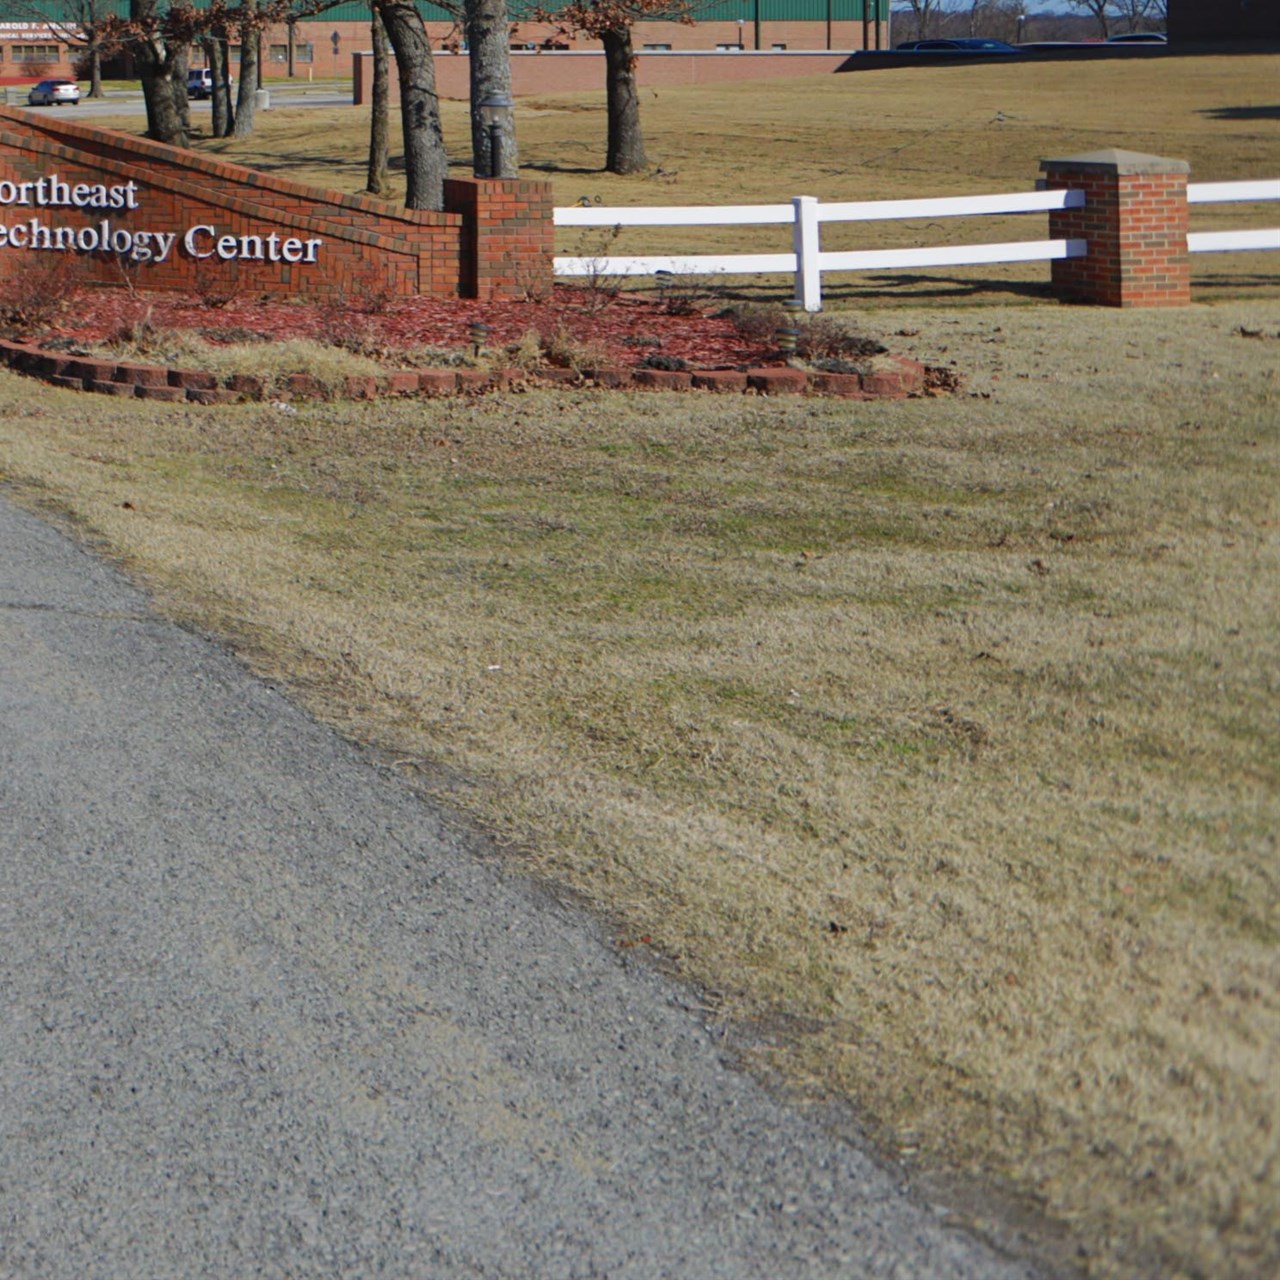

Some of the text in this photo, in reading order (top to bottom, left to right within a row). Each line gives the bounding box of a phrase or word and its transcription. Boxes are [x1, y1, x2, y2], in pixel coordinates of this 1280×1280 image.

[31, 22, 40, 30] F.
[21, 32, 52, 40] SERVICES
[183, 224, 323, 263] Center
